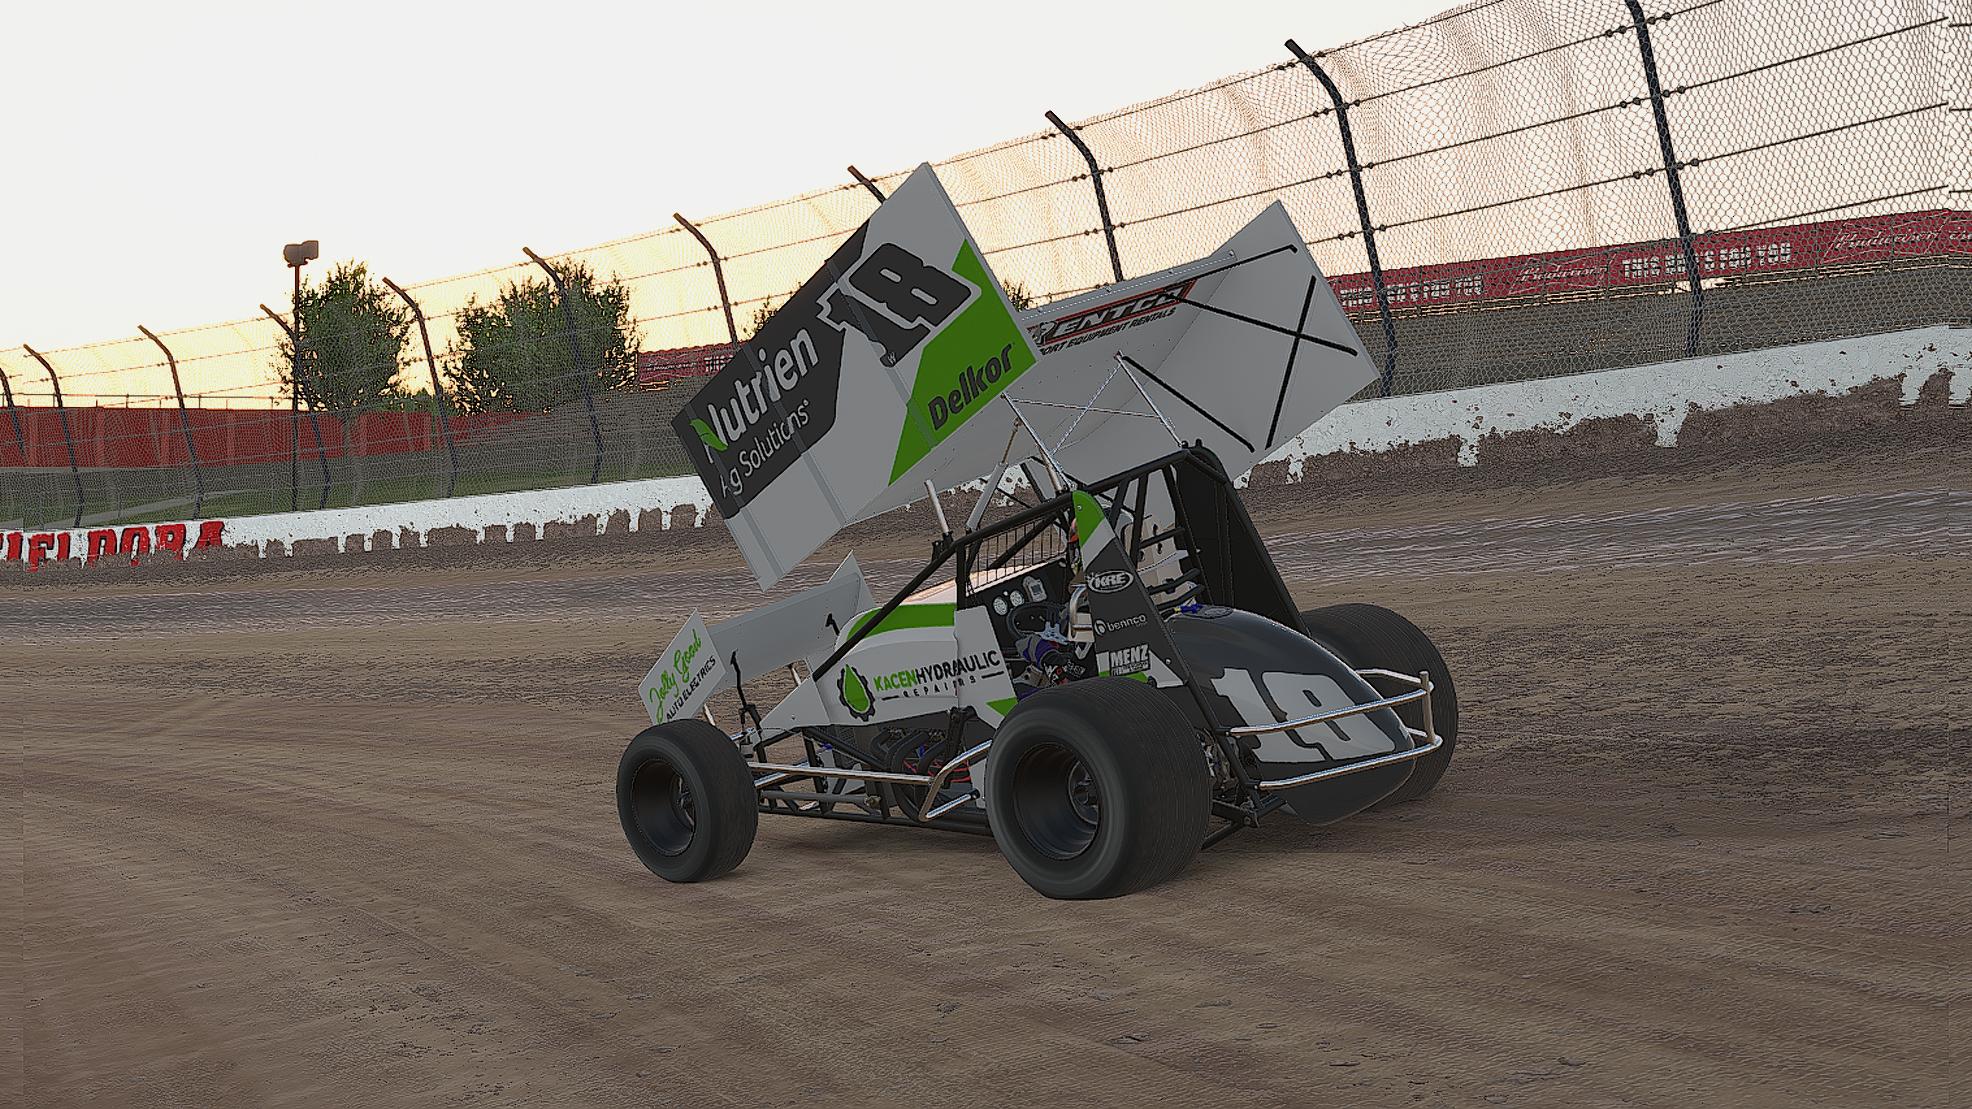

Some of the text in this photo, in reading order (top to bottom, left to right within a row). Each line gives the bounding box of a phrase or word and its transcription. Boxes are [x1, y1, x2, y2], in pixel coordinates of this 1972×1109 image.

[1664, 249, 1716, 275] BU'S
[815, 243, 982, 367] 18
[1066, 324, 1129, 349] EQUIPMENT
[1128, 307, 1177, 329] RENTALS
[690, 327, 820, 464] Nutrien
[928, 344, 1013, 431] Delkor
[739, 404, 809, 477] Solutions
[649, 627, 702, 725] Jolly Good
[902, 674, 977, 699] REPAIRS
[1109, 644, 1149, 668] MENZ
